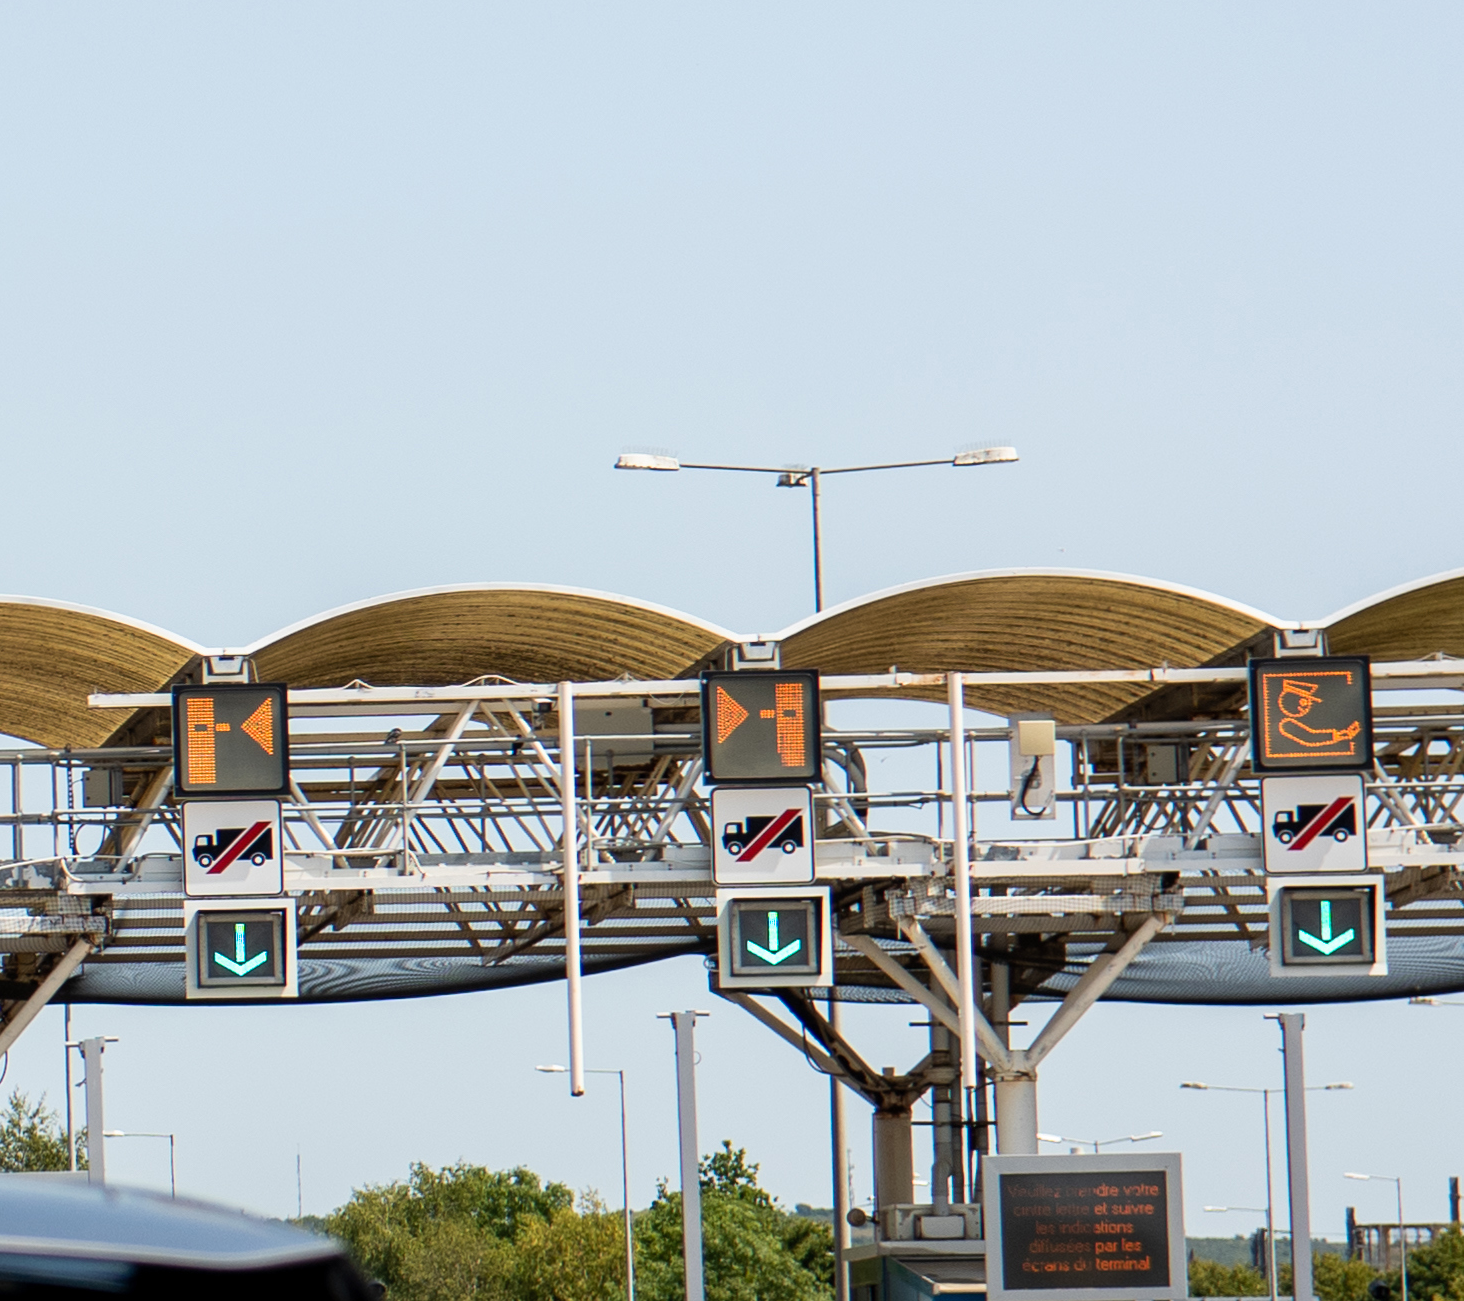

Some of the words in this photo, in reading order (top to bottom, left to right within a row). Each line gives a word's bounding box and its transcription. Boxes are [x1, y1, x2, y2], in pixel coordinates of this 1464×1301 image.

[1123, 1183, 1159, 1197] votre
[1094, 1202, 1108, 1215] et
[1111, 1201, 1155, 1215] suivre
[1094, 1241, 1119, 1255] par
[1120, 1238, 1142, 1253] les
[1095, 1255, 1151, 1272] terminal
